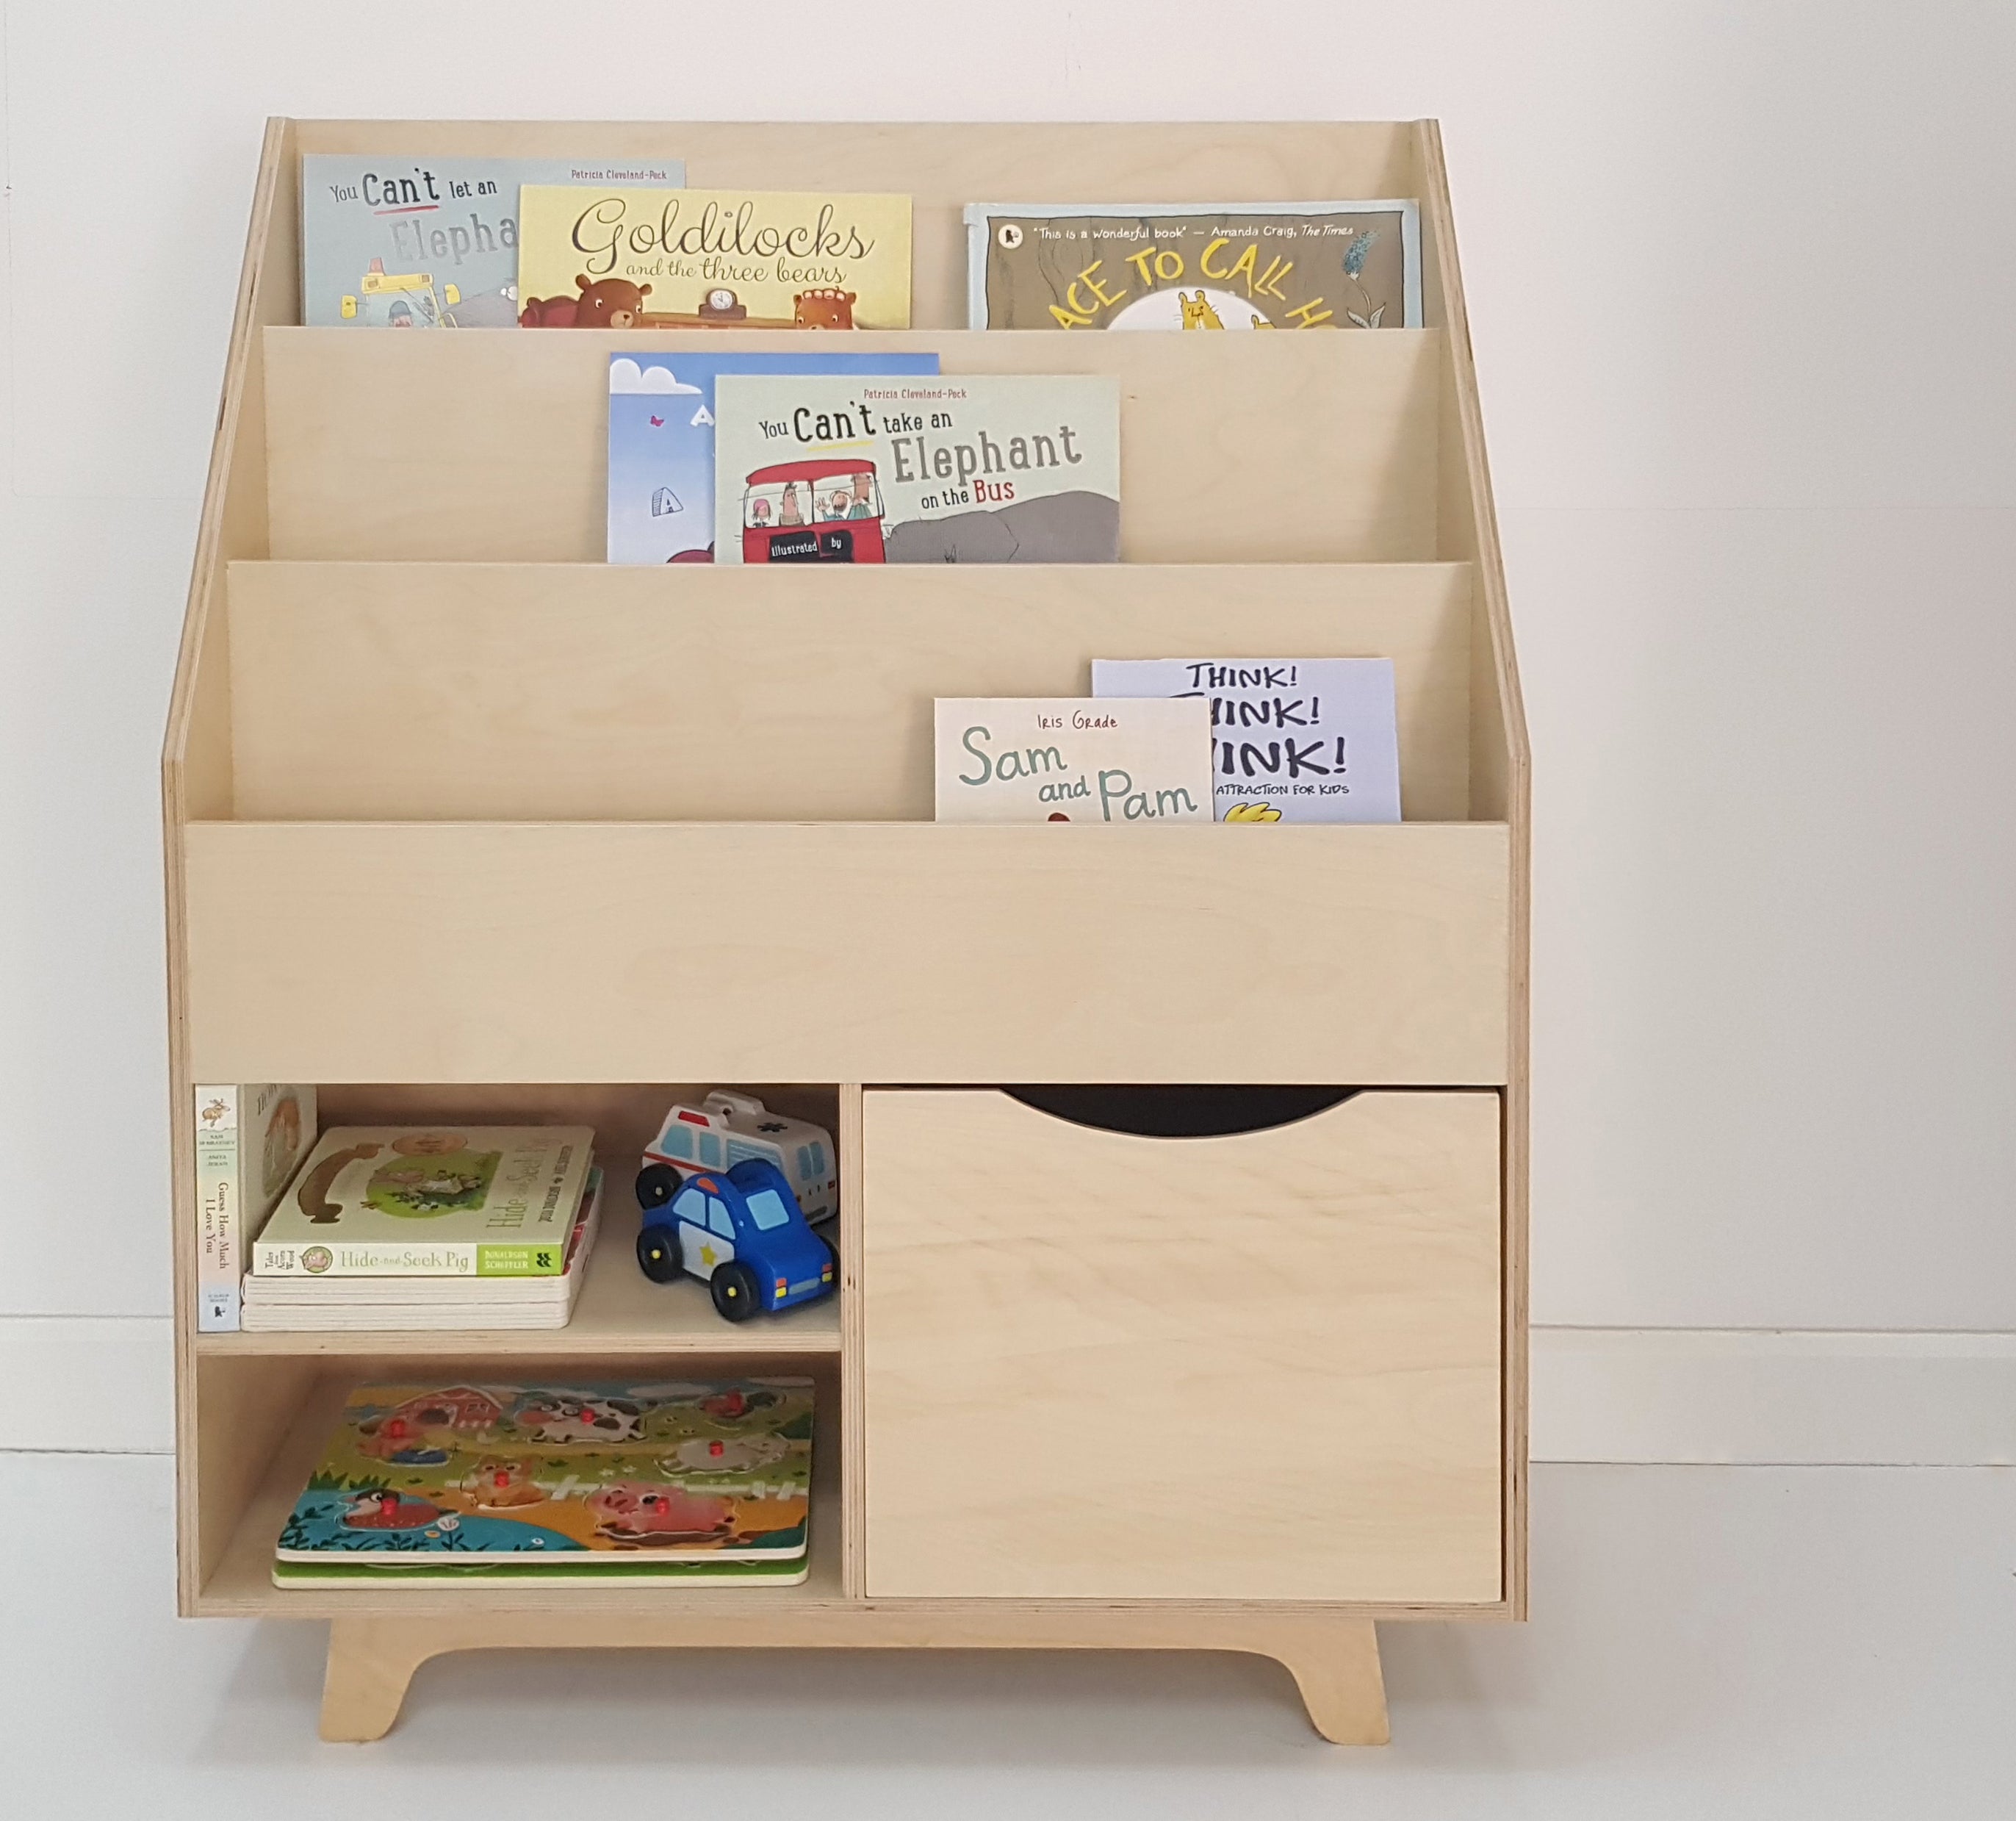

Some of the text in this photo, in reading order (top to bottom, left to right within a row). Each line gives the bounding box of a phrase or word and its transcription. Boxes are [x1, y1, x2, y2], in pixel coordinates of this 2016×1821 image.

[330, 168, 497, 206] You Can't let an
[571, 170, 667, 179] Patricia Cleveland-Peck
[571, 198, 875, 275] Goldilocks
[1066, 229, 1076, 240] is
[1081, 230, 1087, 239] a
[1092, 226, 1149, 241] wonderful
[1211, 226, 1259, 237] Amanda
[1263, 226, 1297, 239] Craig,
[1301, 224, 1320, 236] The
[1322, 224, 1354, 237] Times
[626, 255, 848, 284] and the three bears
[1125, 246, 1185, 286] TO
[1200, 237, 1294, 301] CALL
[864, 388, 968, 399] Patricia Cleveland-Peck
[759, 401, 953, 443] You Can't take an
[891, 425, 1082, 486] Elephant
[921, 479, 1015, 509] on the Bus
[771, 537, 842, 557] Illustrated by
[1186, 663, 1297, 689] THINK!
[1168, 692, 1320, 728] INK!
[959, 726, 1068, 786] Sam
[1212, 736, 1347, 779] INK!
[1038, 769, 1198, 822] and Pam
[1216, 783, 1350, 795] ATTRACTION FOR KIDS
[206, 1207, 216, 1230] Love
[218, 1182, 230, 1269] Guess How Much
[206, 1233, 216, 1254] You
[446, 1251, 469, 1272] Pig
